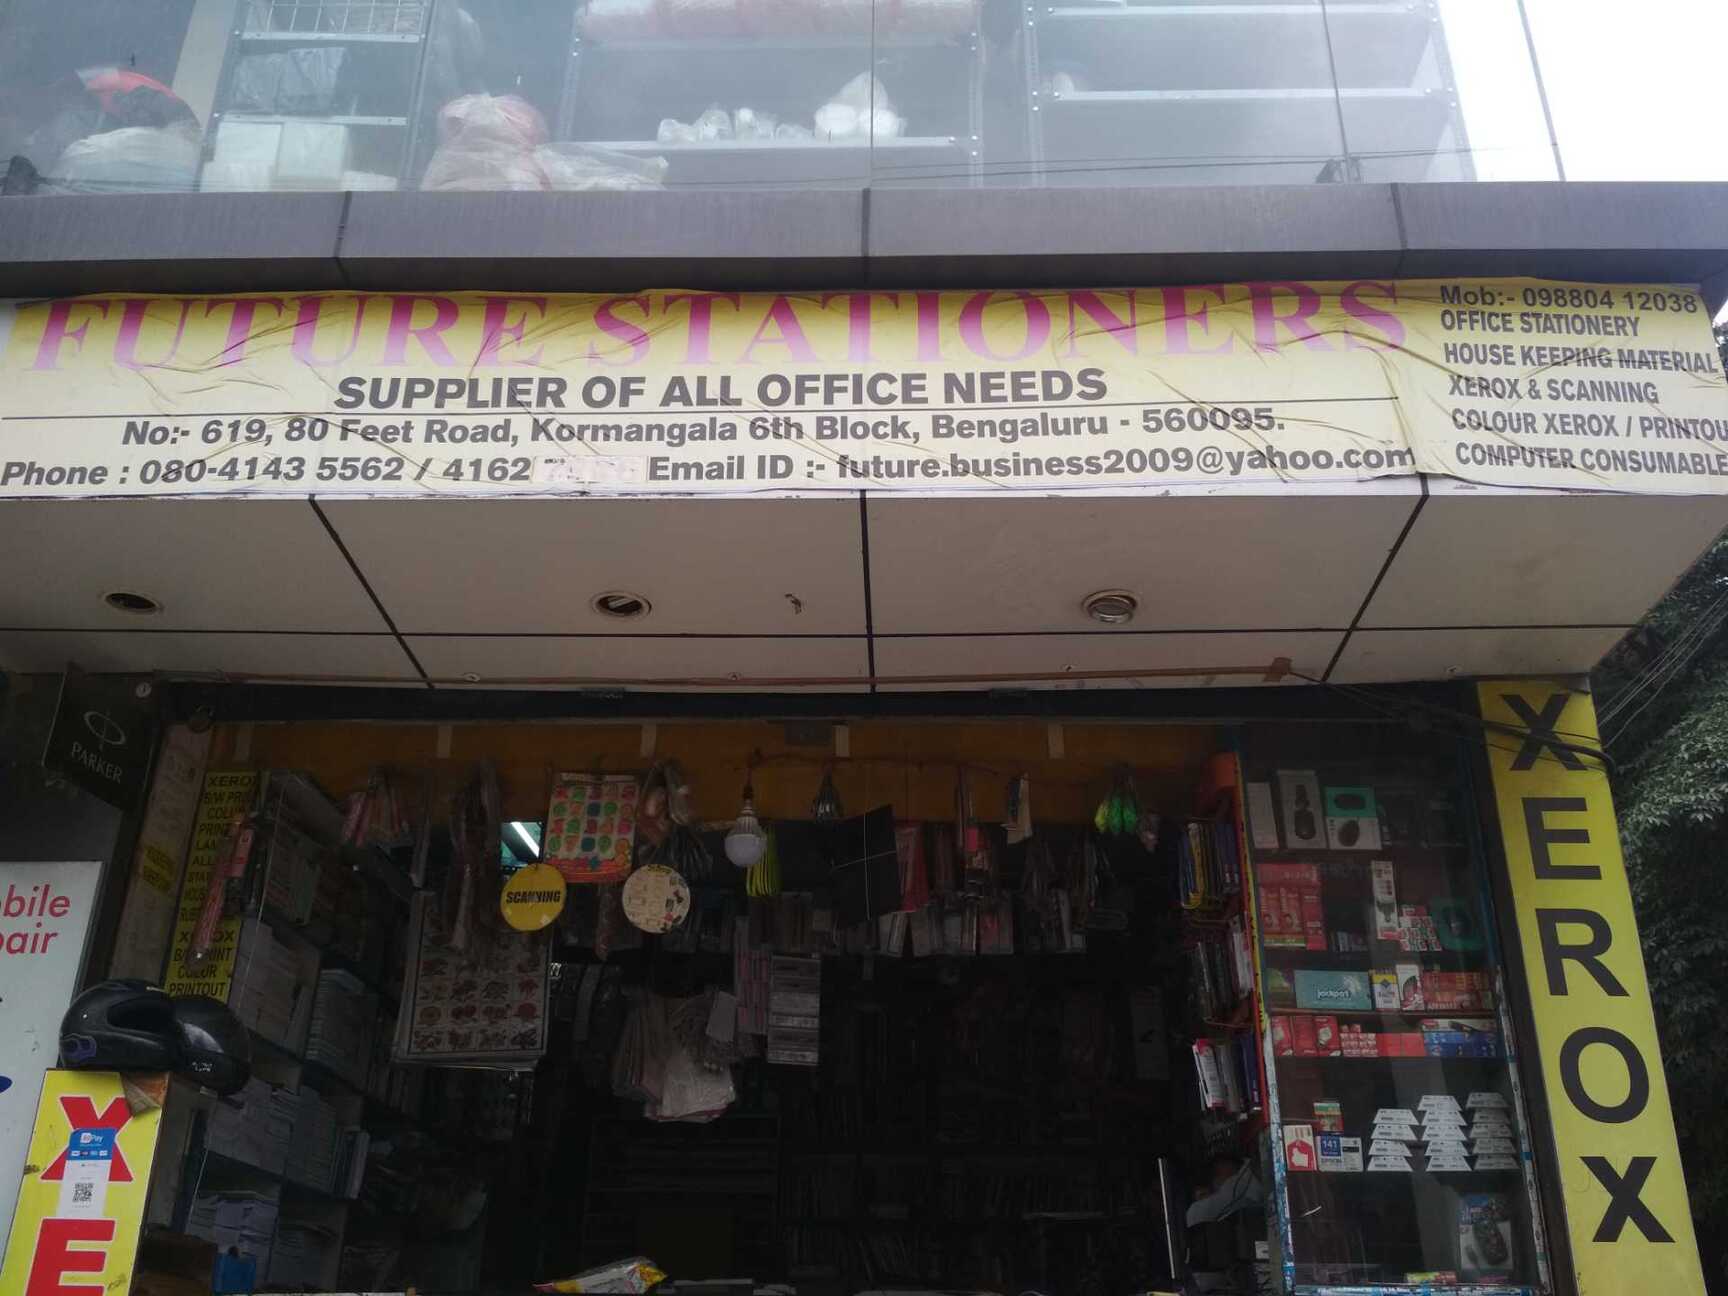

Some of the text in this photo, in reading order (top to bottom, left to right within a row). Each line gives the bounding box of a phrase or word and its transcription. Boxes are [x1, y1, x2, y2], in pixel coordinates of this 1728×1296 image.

[1440, 285, 1698, 313] Mob:- 098804 12038
[26, 281, 1407, 371] FUTURE STATIONERS
[1441, 310, 1640, 337] OFFICE STATIONERY
[1444, 343, 1719, 374] HOUSE KEEPING MATERIAL
[334, 367, 1108, 409] SUPPLIER OF ALL OFFICE NEEDS
[1449, 375, 1659, 404] XEROX & SCANNING
[122, 420, 190, 446] No:-
[201, 418, 272, 447] 619,
[285, 418, 328, 443] 80
[340, 418, 416, 444] Feet
[424, 418, 519, 448] Road,
[531, 416, 737, 448] Kormangala
[749, 415, 804, 440] 6th
[816, 415, 920, 444] Block,
[932, 413, 1108, 443] Bengaluru
[1142, 407, 1285, 433] 560095.
[1452, 408, 1538, 435] COLOUR
[1544, 412, 1620, 437] XEROX
[1625, 416, 1633, 438] /
[1, 446, 1415, 487] Phone : 080-4143 5562 / 4162 Email ID :- future.business2009@yahoo.com
[1455, 441, 1728, 476] COMPUTER CONSUMABLE
[71, 741, 123, 784] PARKER
[0, 884, 72, 918] bile
[178, 930, 236, 943] XOX
[1501, 693, 1676, 1243] XEROX
[169, 982, 226, 996] PRINTOUT
